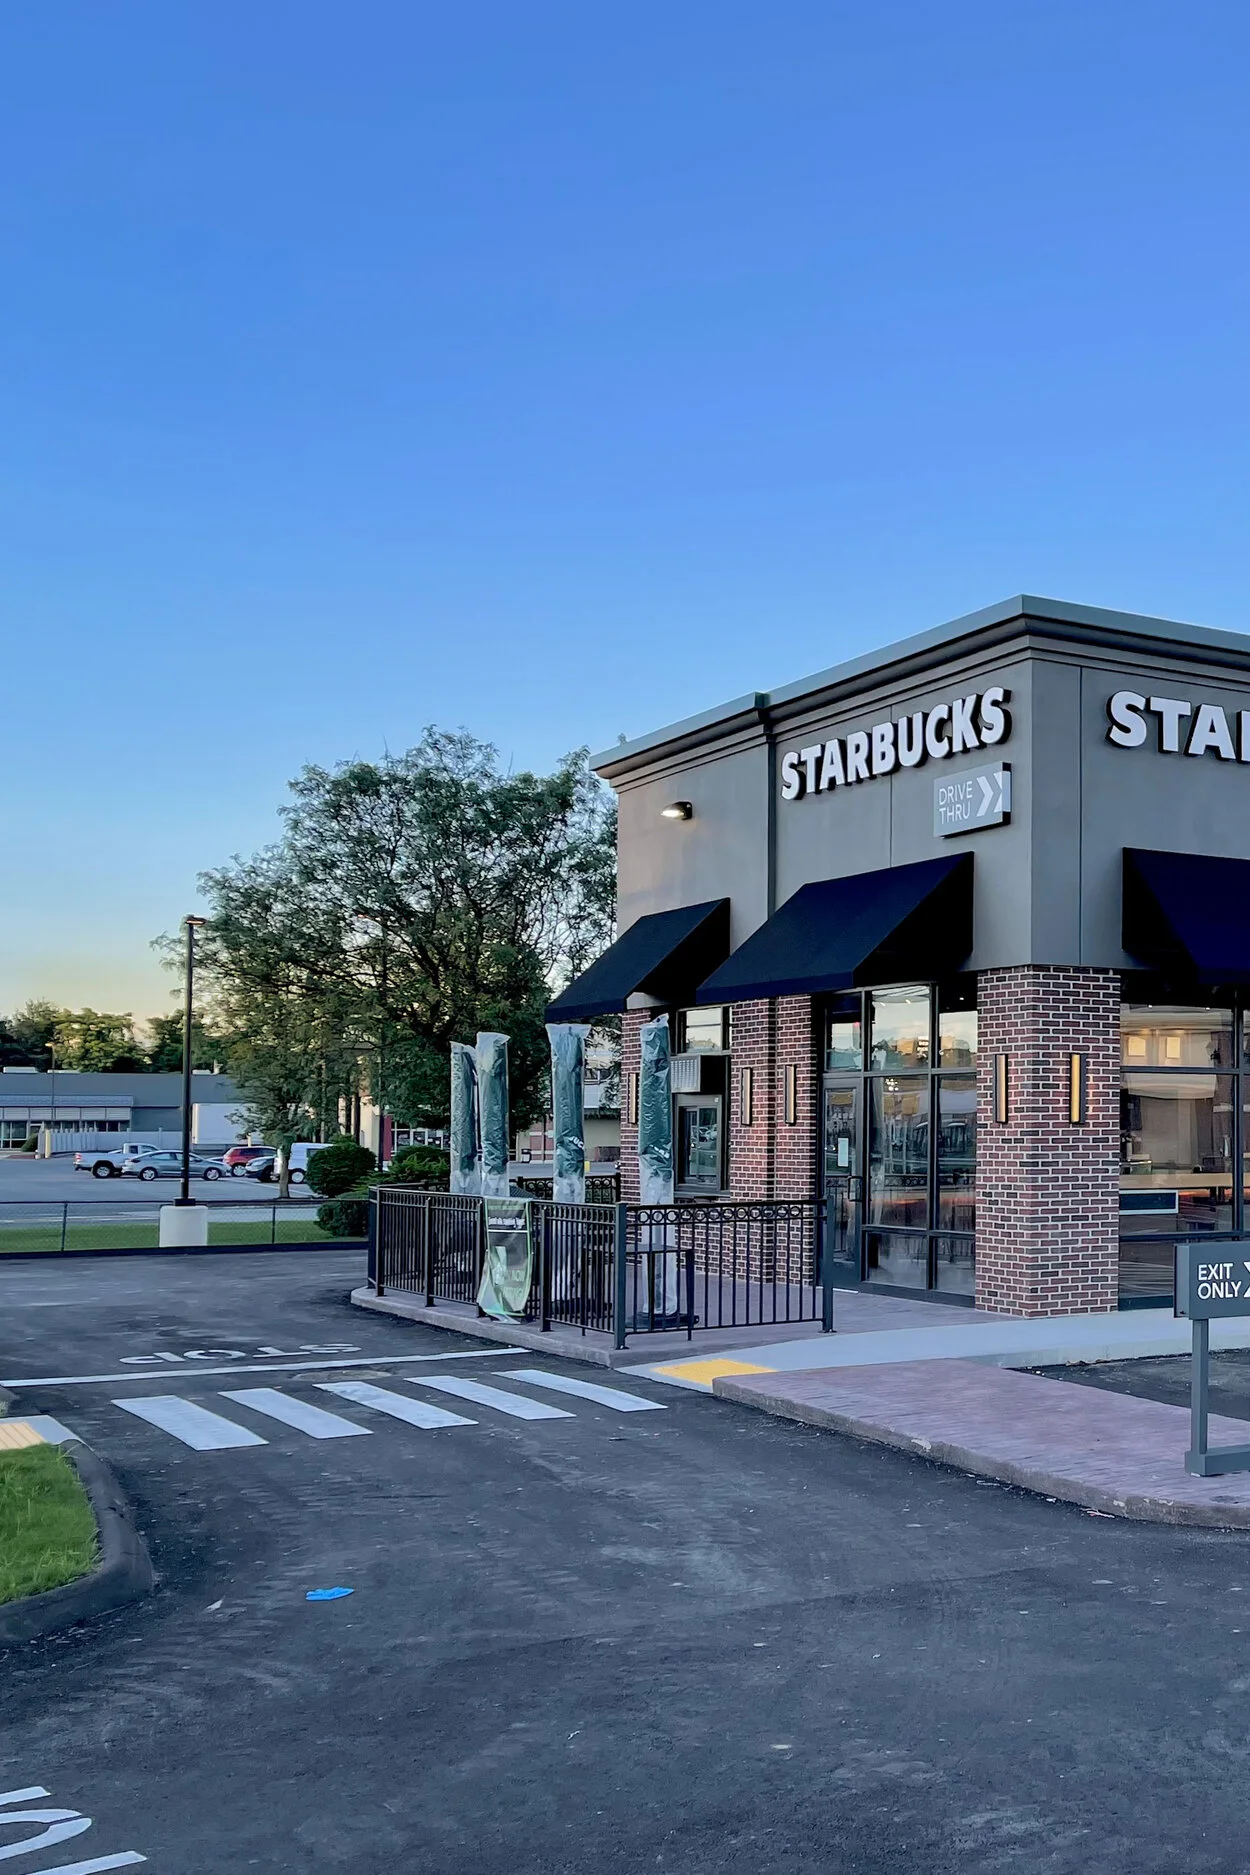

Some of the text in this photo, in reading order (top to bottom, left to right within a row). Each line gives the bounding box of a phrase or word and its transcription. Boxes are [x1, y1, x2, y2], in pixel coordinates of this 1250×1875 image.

[781, 686, 1005, 800] STARBUCKS
[939, 781, 973, 805] DRIVE
[939, 802, 971, 824] THRU
[1198, 1263, 1233, 1280] EXIT
[1197, 1281, 1242, 1300] ONLY
[119, 1343, 362, 1364] STOP
